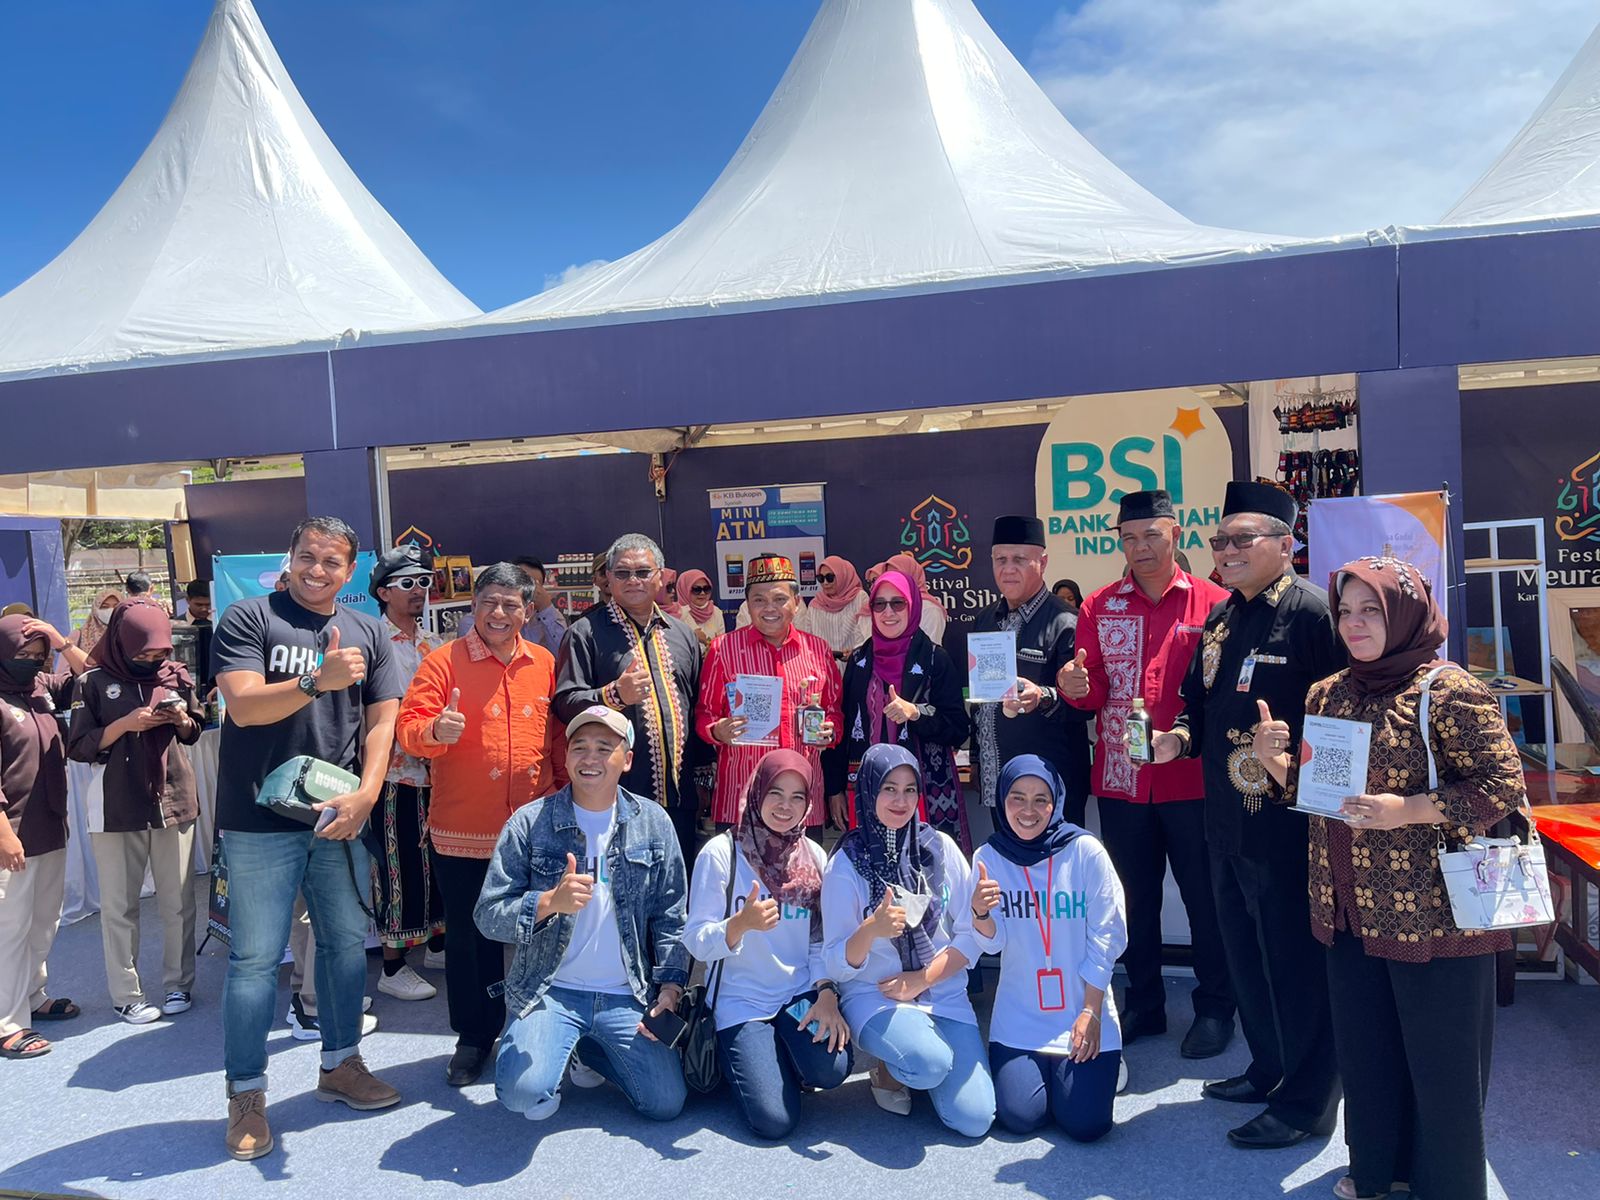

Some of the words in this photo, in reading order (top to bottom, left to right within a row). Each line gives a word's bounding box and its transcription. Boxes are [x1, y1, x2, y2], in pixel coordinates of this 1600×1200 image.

[1051, 434, 1184, 511] BSI
[735, 491, 762, 499] Bukopin
[721, 507, 760, 519] MINI
[717, 520, 766, 539] ATM
[1048, 513, 1112, 535] BANK
[1075, 531, 1204, 555] INDIA
[1558, 548, 1600, 563] Fest
[925, 576, 970, 591] stival
[1516, 568, 1600, 588] Meura
[335, 592, 366, 604] adiah
[1517, 592, 1539, 602] Kar
[999, 890, 1086, 919] AKHLAK
